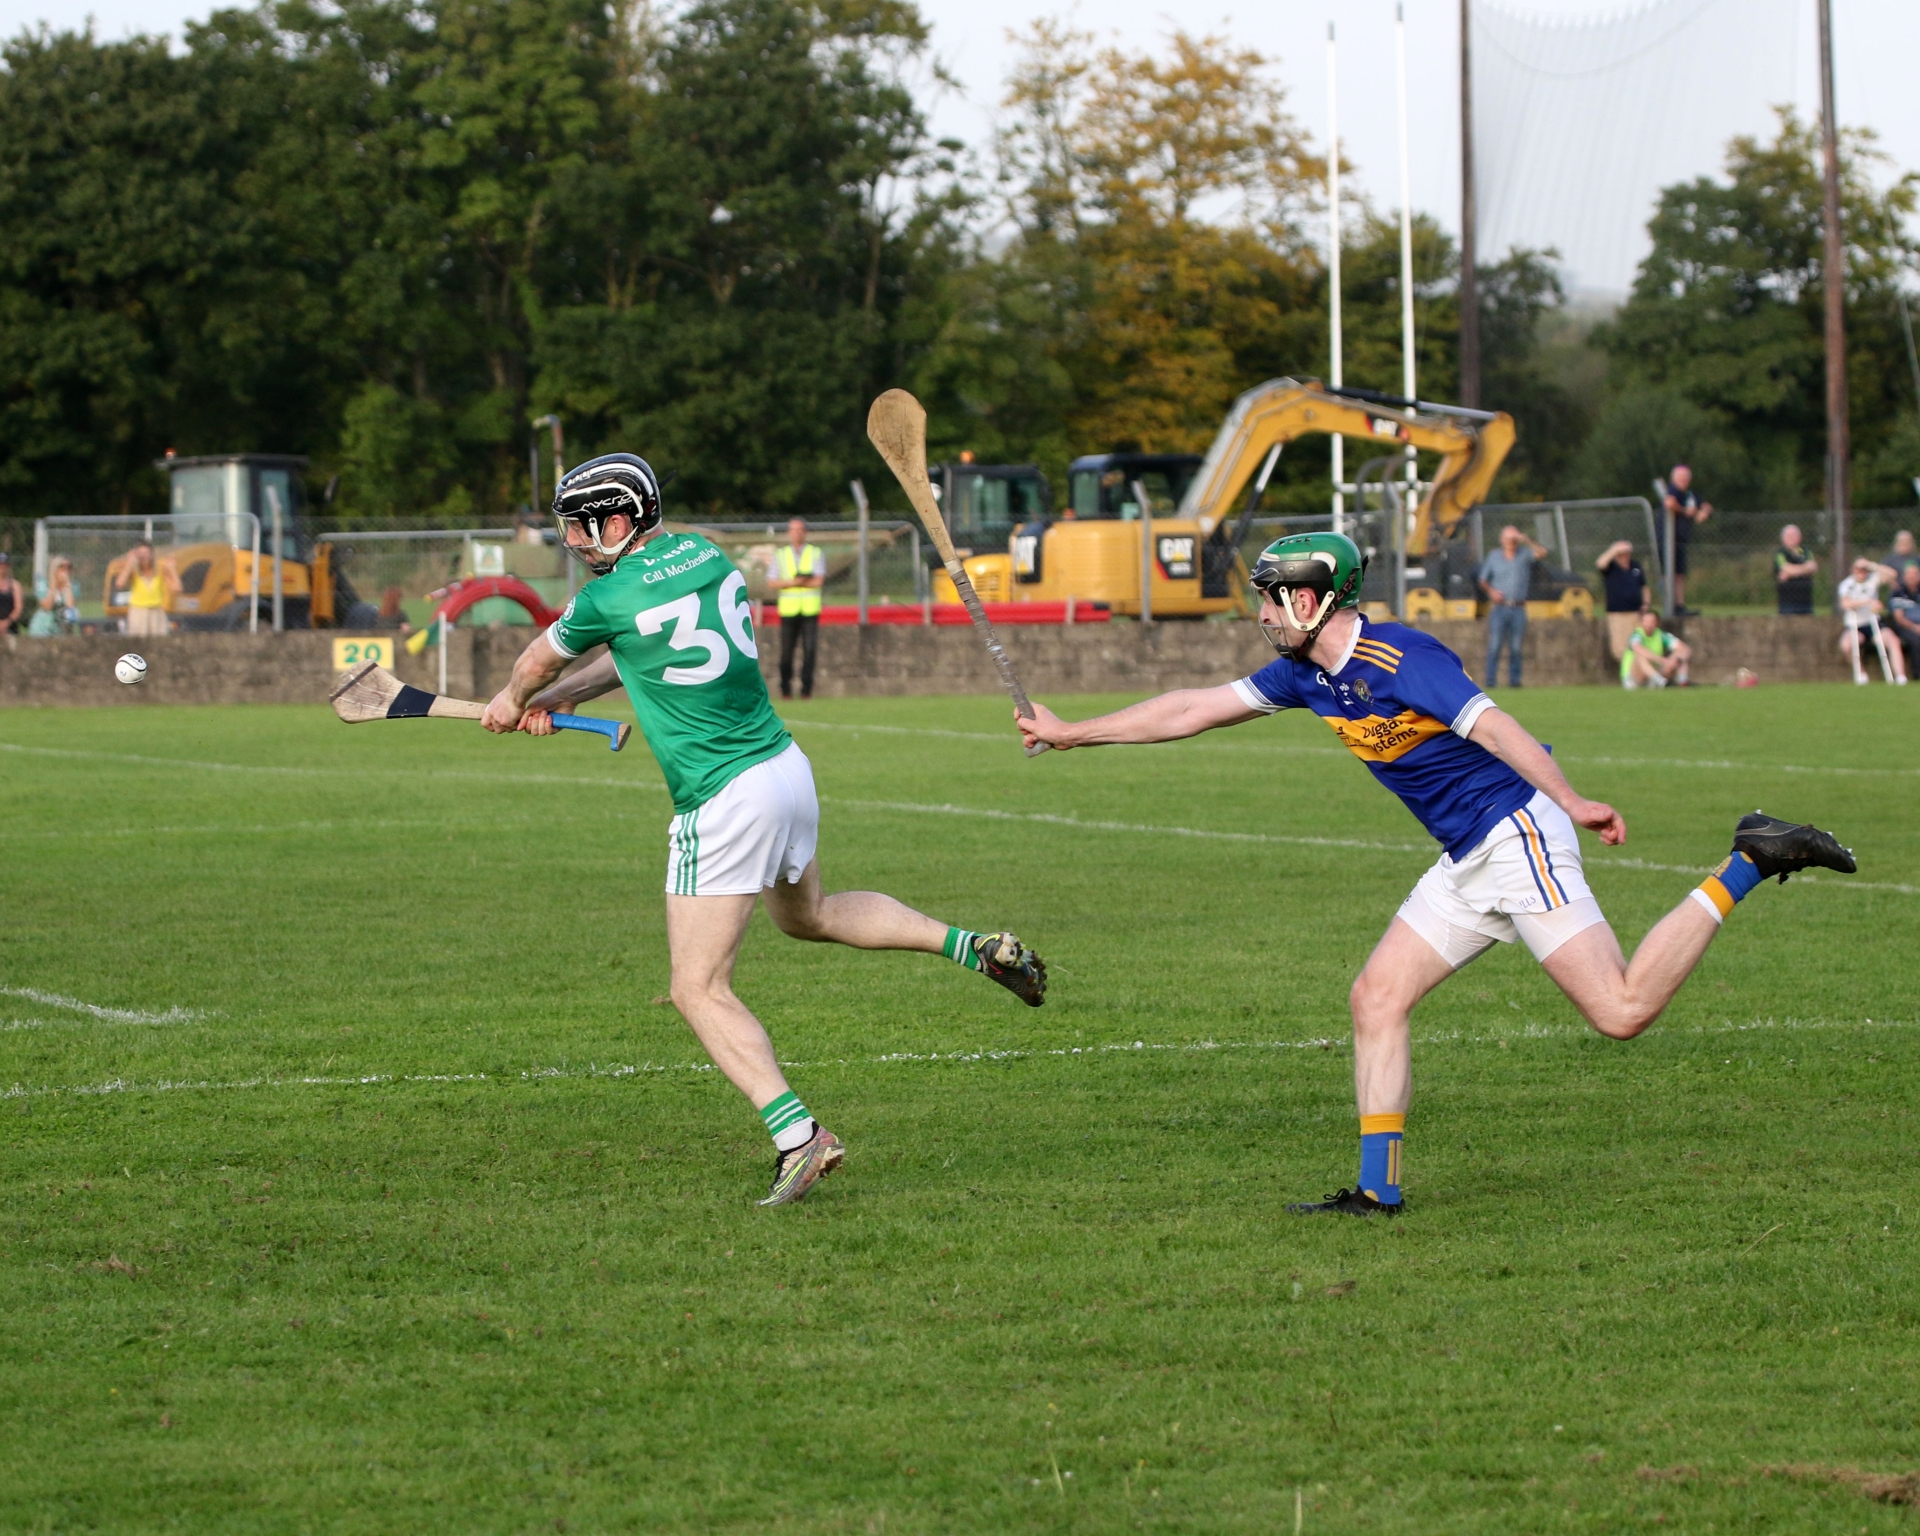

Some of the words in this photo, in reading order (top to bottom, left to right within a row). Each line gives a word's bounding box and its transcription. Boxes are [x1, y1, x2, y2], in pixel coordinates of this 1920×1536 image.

[1159, 538, 1194, 562] CAT
[635, 569, 758, 686] 36
[343, 643, 382, 664] 20
